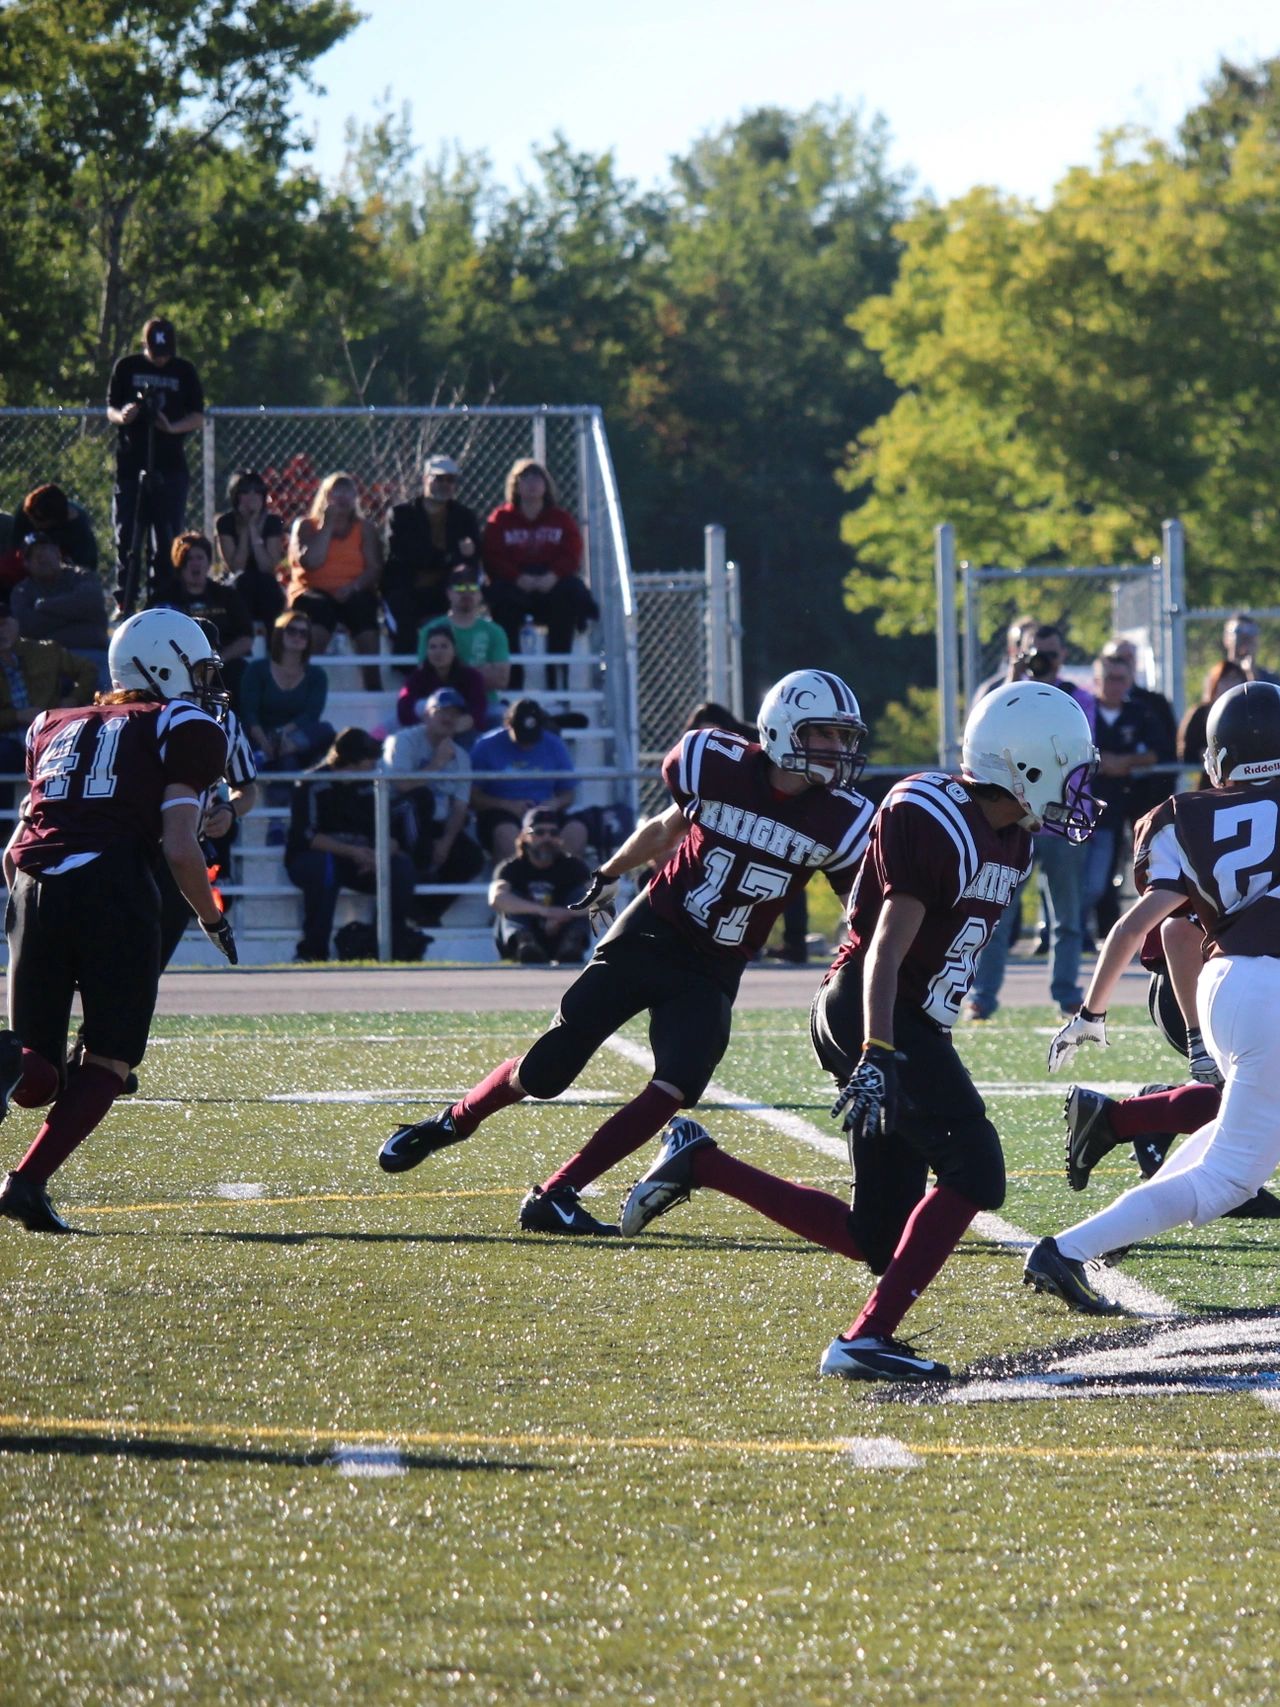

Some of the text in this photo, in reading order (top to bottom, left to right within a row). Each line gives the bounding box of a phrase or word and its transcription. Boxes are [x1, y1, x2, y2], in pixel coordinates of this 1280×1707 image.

[35, 716, 130, 800] 41
[1243, 762, 1280, 776] Riddell
[700, 799, 833, 867] KNIGHTS
[684, 846, 793, 947] 17
